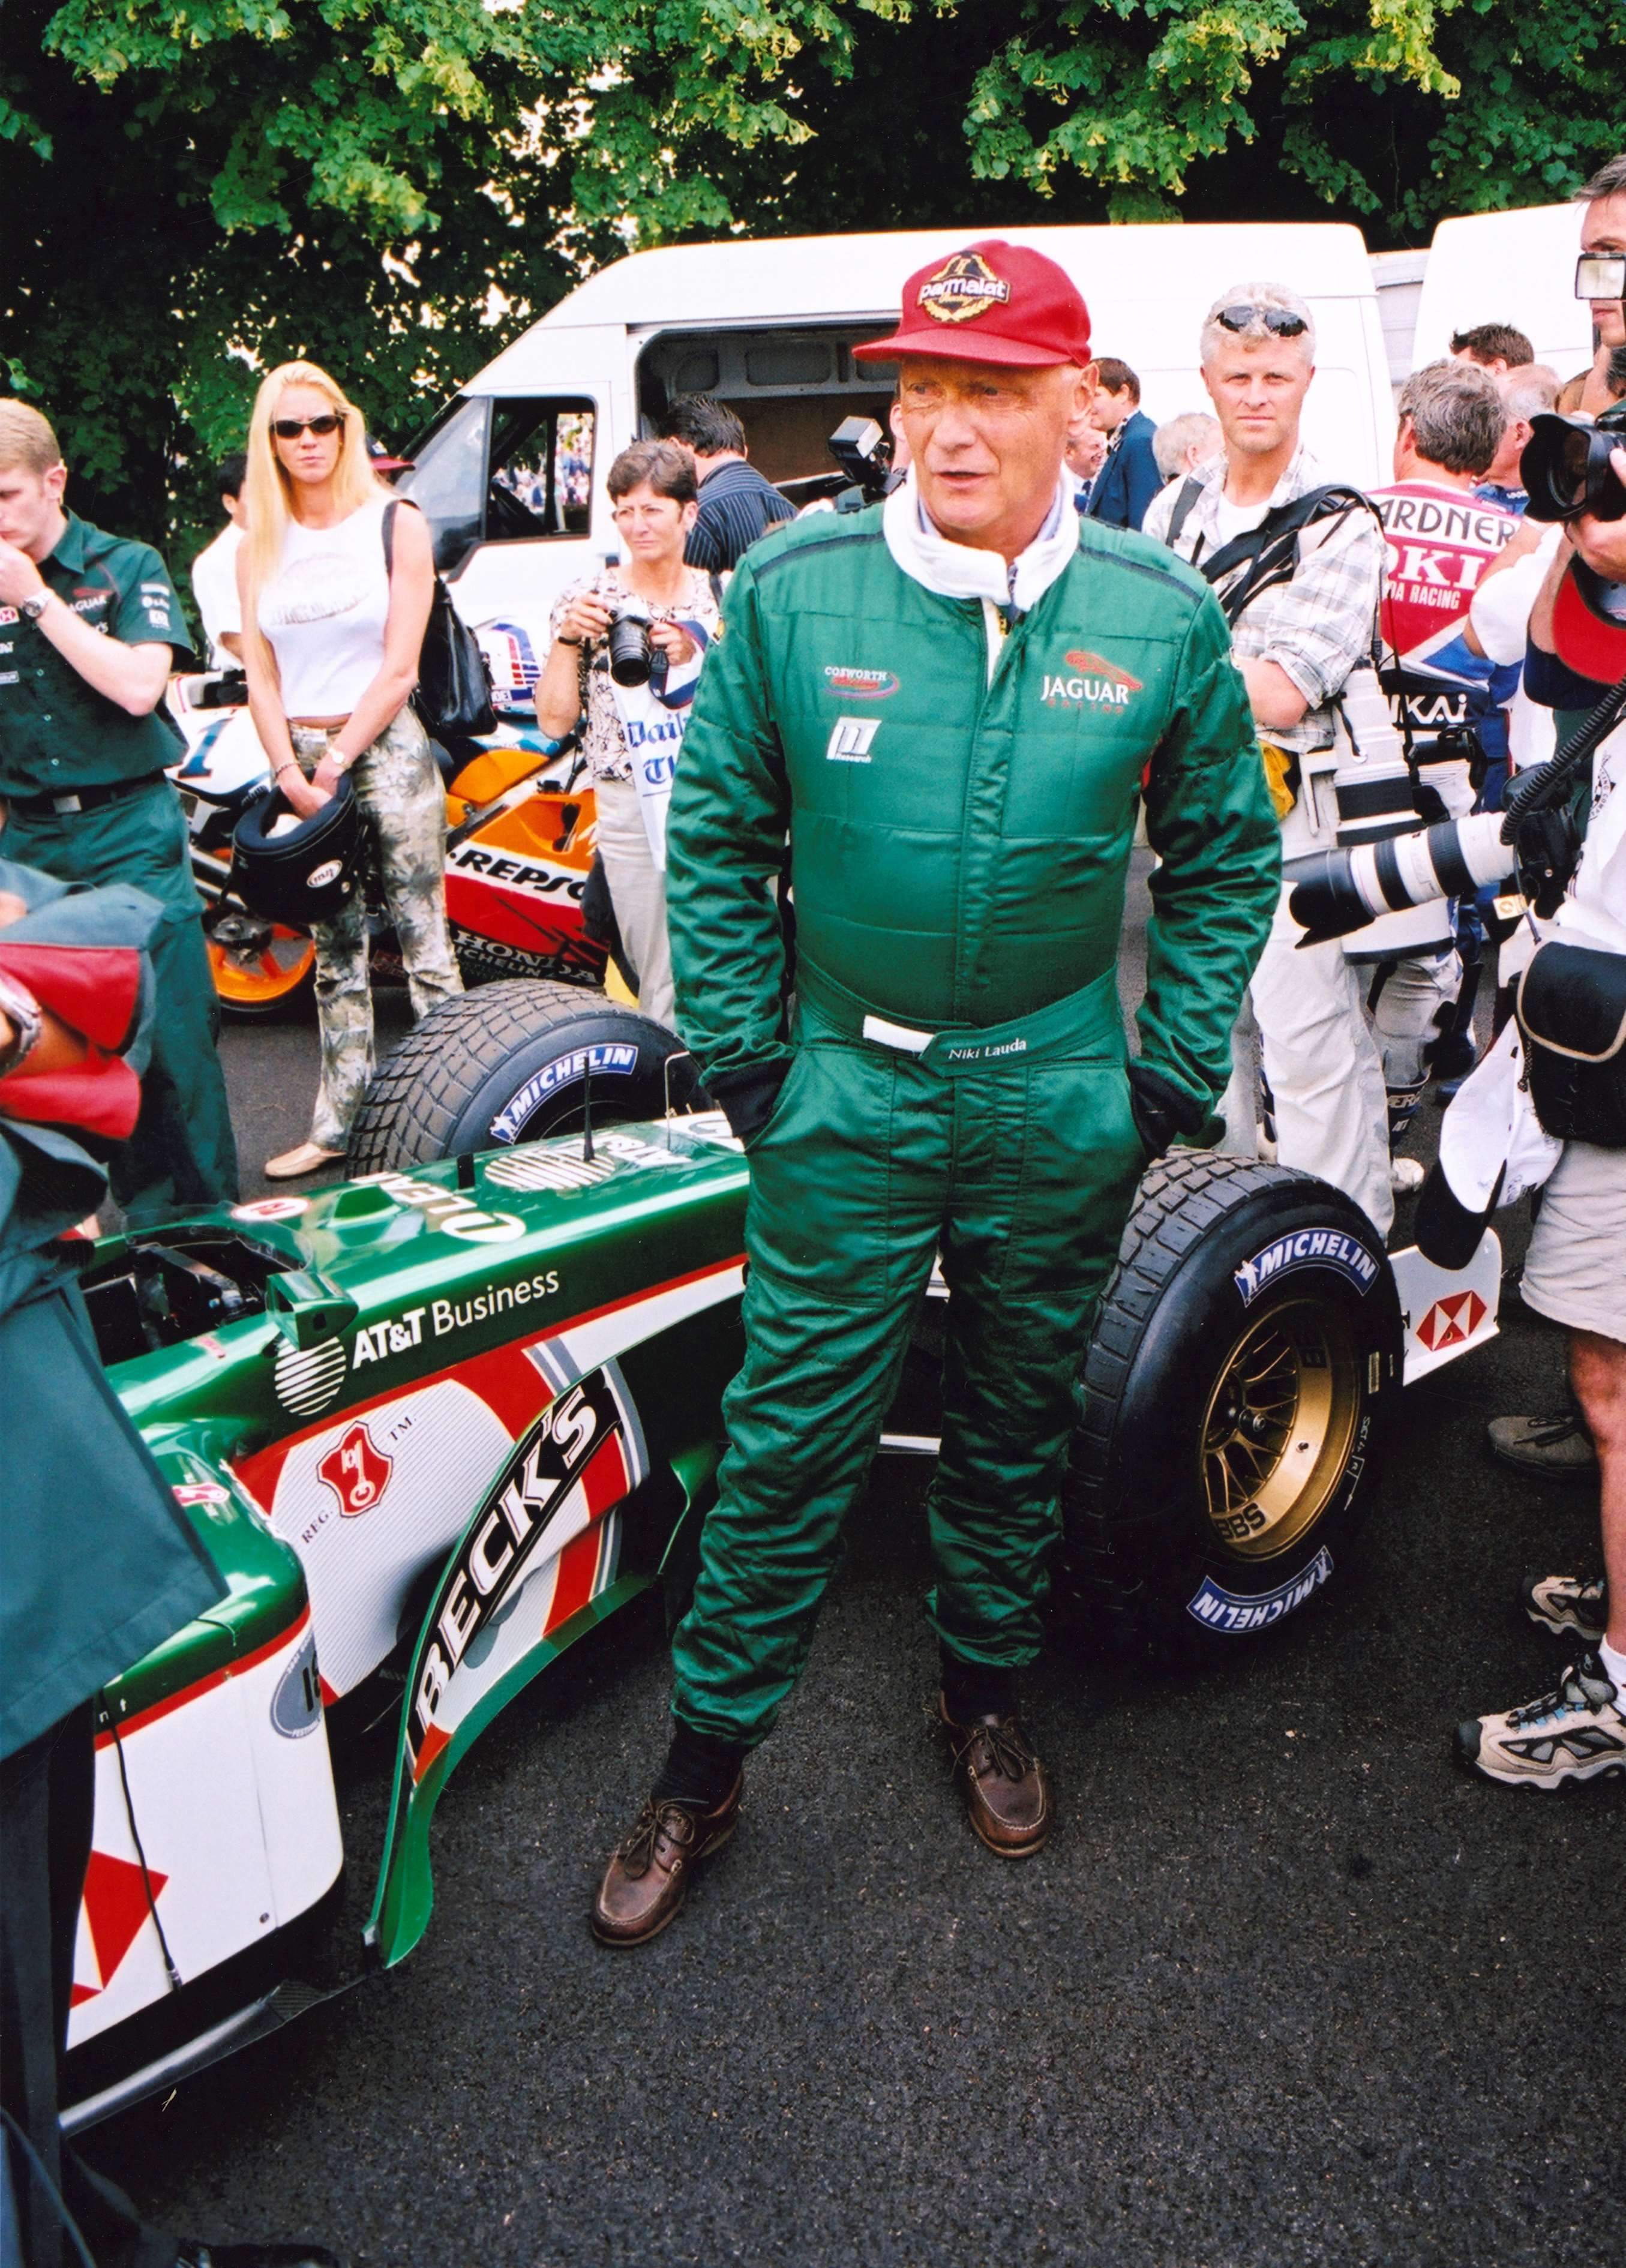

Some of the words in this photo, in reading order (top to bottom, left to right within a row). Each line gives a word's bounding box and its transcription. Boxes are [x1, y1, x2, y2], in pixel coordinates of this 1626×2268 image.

[918, 277, 1006, 304] parmalat
[1379, 499, 1516, 546] ARDNER
[70, 596, 107, 611] AGUAR
[1409, 583, 1461, 610] RACING
[824, 666, 887, 681] COSWORTH
[1040, 675, 1129, 704] JAGUAR
[178, 717, 235, 779] 1
[627, 712, 687, 748] Dail
[455, 849, 586, 901] REPSO
[456, 946, 541, 977] ICHELIN
[949, 1048, 980, 1060] Niki
[985, 1037, 1027, 1057] Lauda
[511, 1046, 634, 1123] MICHELIN
[1259, 1232, 1376, 1282] MICHELIN
[352, 1307, 426, 1370] AT&T
[431, 1270, 559, 1337] Business
[1216, 1502, 1267, 1540] BBS
[415, 1384, 597, 1735] BECK'S
[1193, 1571, 1316, 1629] MICHELIN
